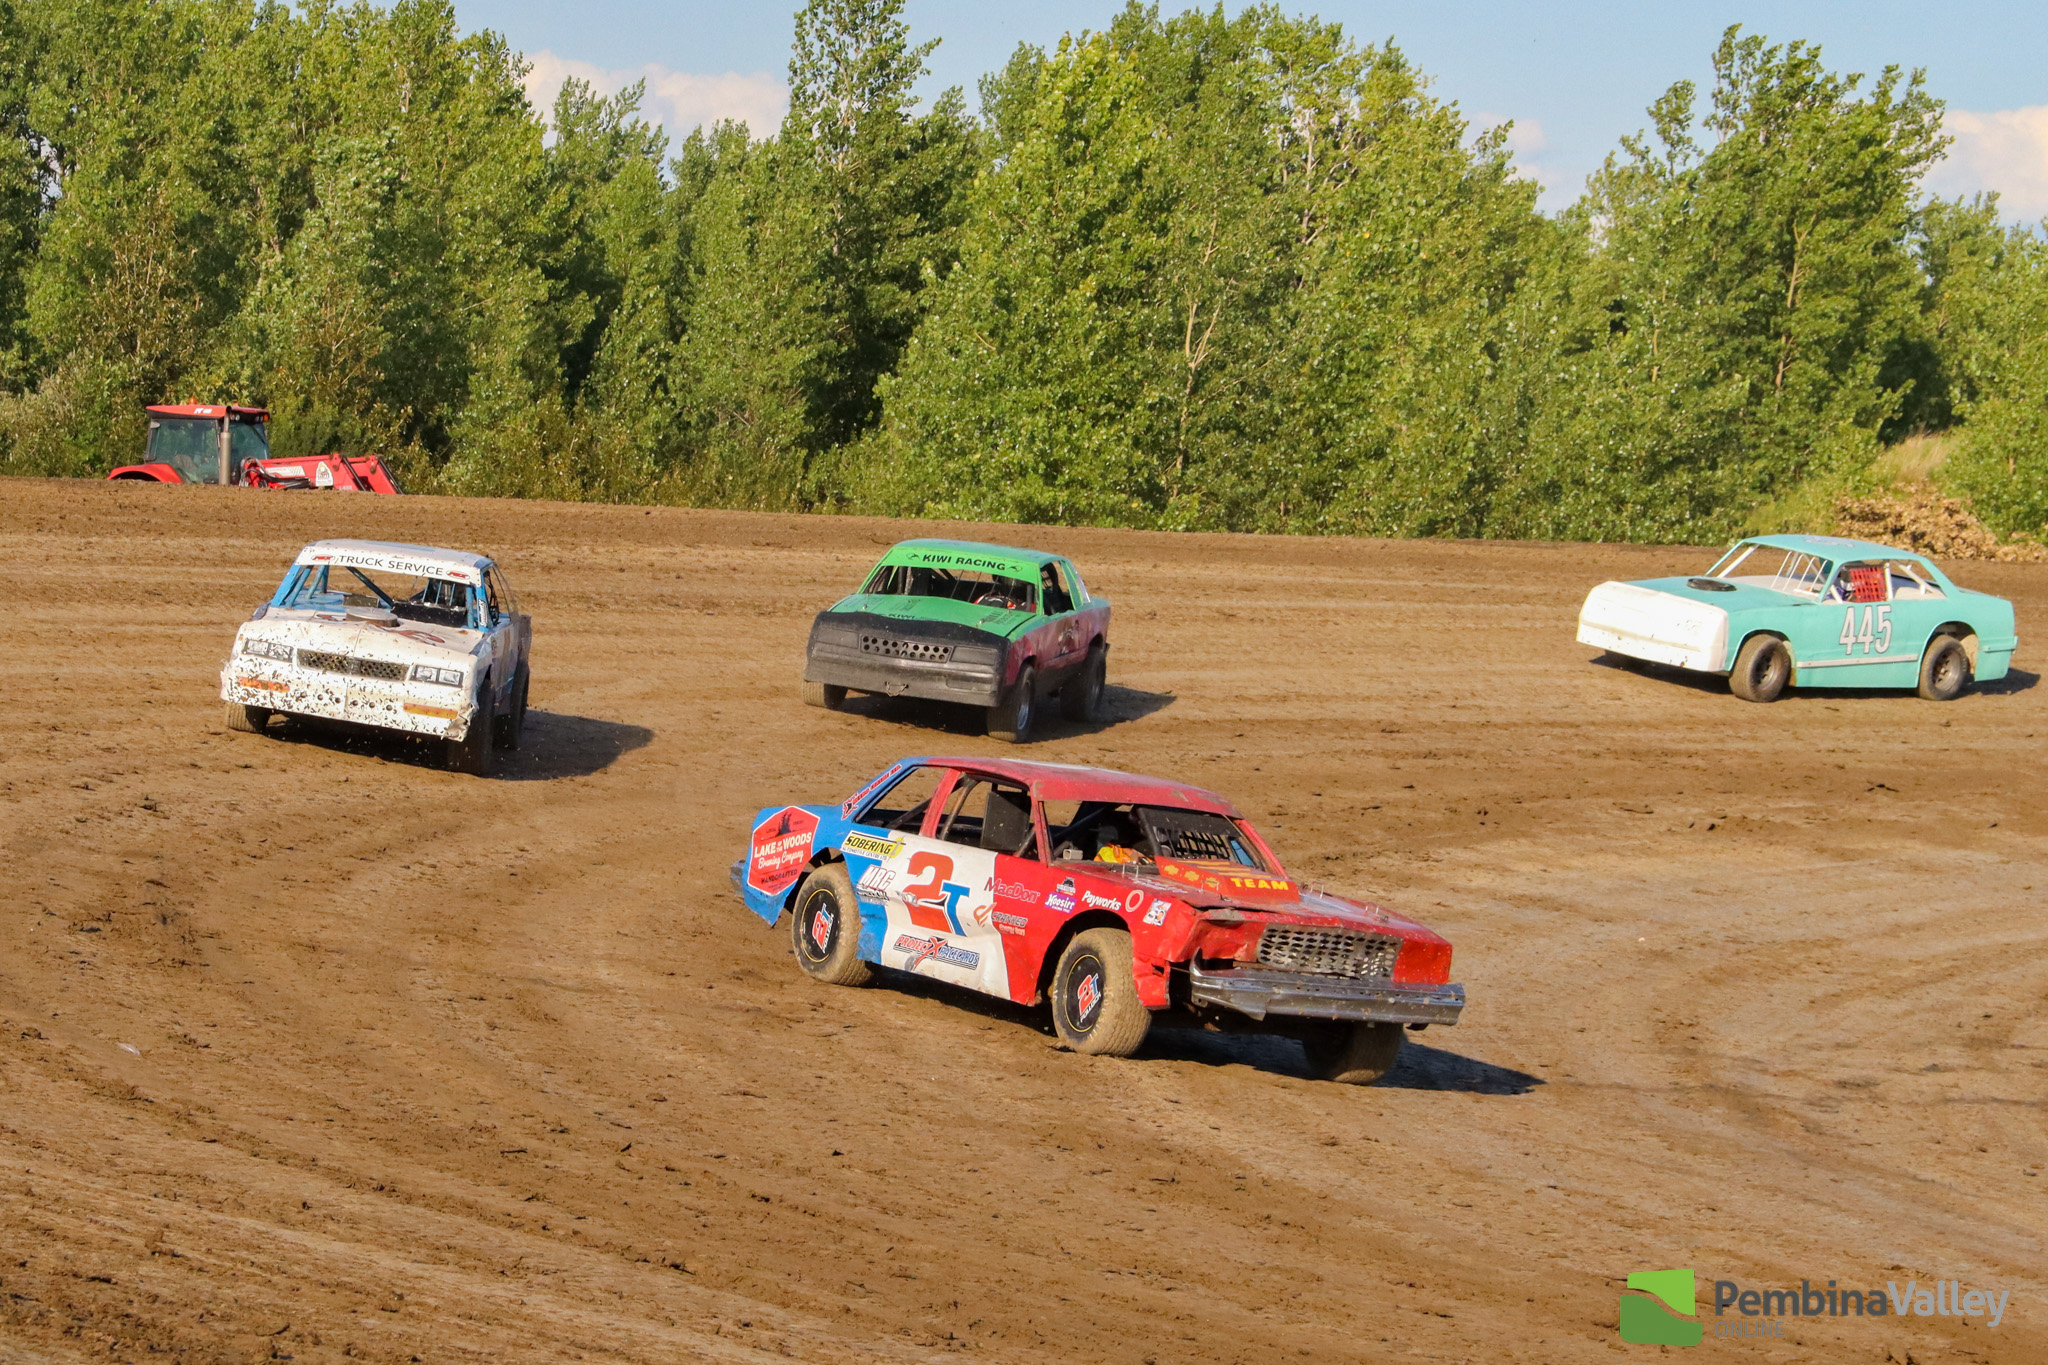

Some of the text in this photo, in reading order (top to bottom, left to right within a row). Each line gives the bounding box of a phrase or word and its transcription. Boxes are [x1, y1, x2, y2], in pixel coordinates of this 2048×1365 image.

[338, 555, 384, 567] TRUCK
[388, 560, 444, 576] SERVICE
[922, 554, 1006, 571] KIWI RACING
[1839, 604, 1893, 655] 445
[754, 841, 777, 858] LAKE
[783, 832, 812, 851] WOODS
[845, 835, 893, 855] SOBERING
[758, 850, 804, 869] Brewing Company
[761, 869, 798, 884] HANDCRAFTED
[858, 864, 896, 891] MRC
[1230, 878, 1289, 891] TEAM
[902, 850, 970, 937] 2T
[984, 876, 1039, 904] MacDon
[1081, 890, 1122, 911] Payworks
[1044, 893, 1076, 910] Hoosier
[992, 911, 1028, 928] CRANKED
[896, 936, 932, 952] PROJECT
[939, 946, 980, 965] RACECARDS
